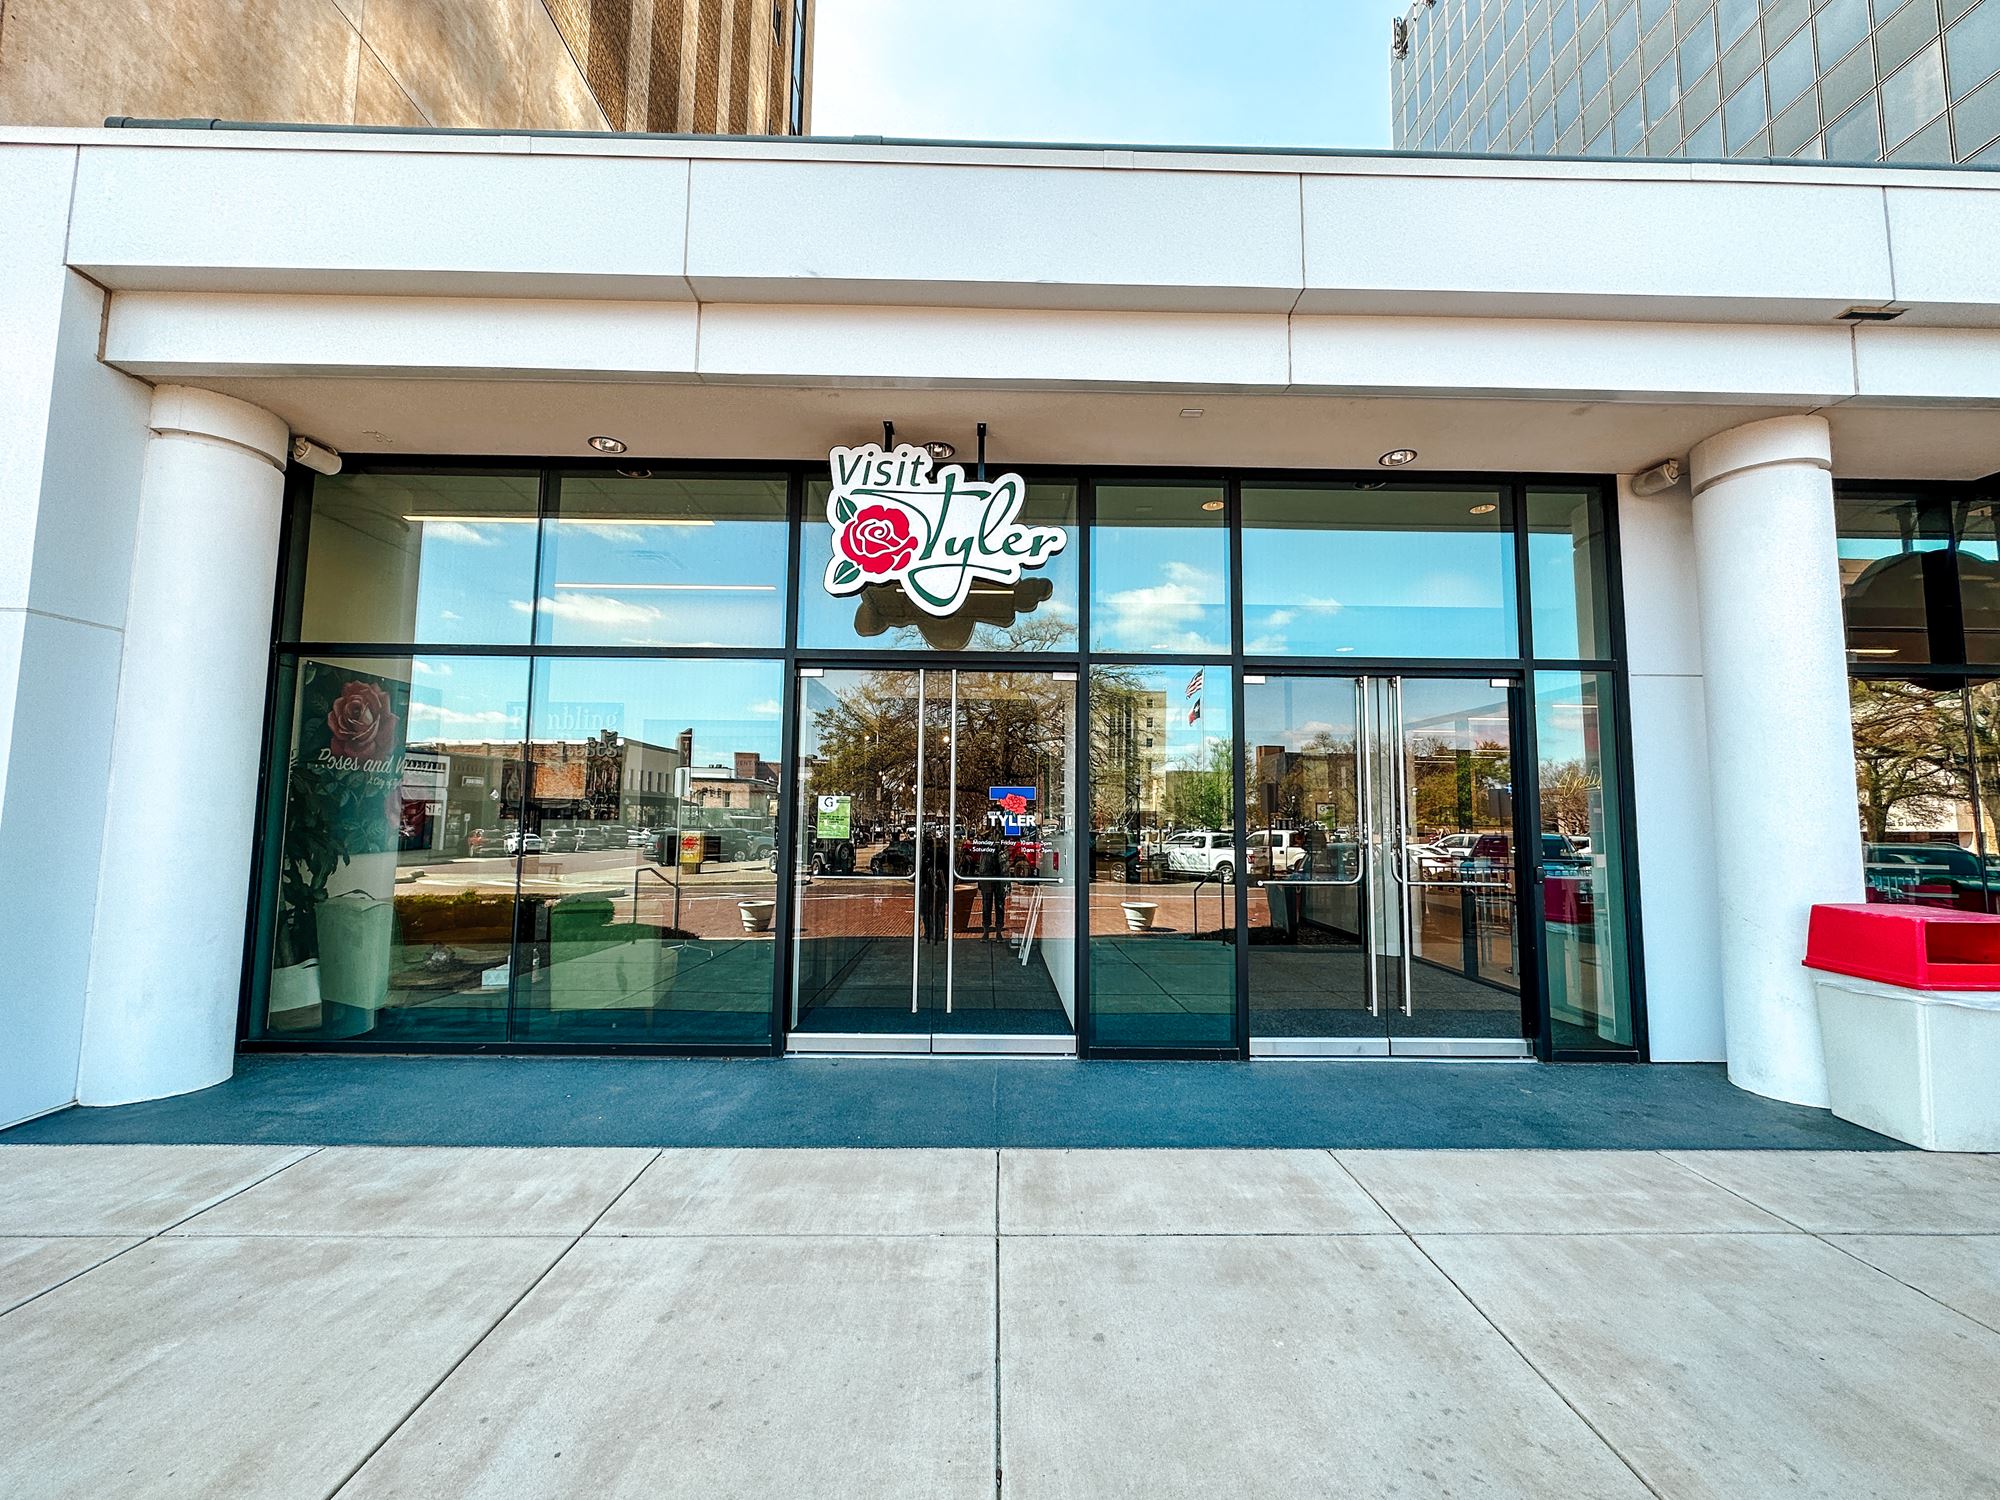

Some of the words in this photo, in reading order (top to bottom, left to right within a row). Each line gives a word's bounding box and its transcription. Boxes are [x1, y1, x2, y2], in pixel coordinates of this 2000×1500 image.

[838, 450, 925, 487] Visit
[850, 472, 1058, 607] Tyler
[363, 755, 395, 773] and
[988, 814, 1036, 826] TYLER
